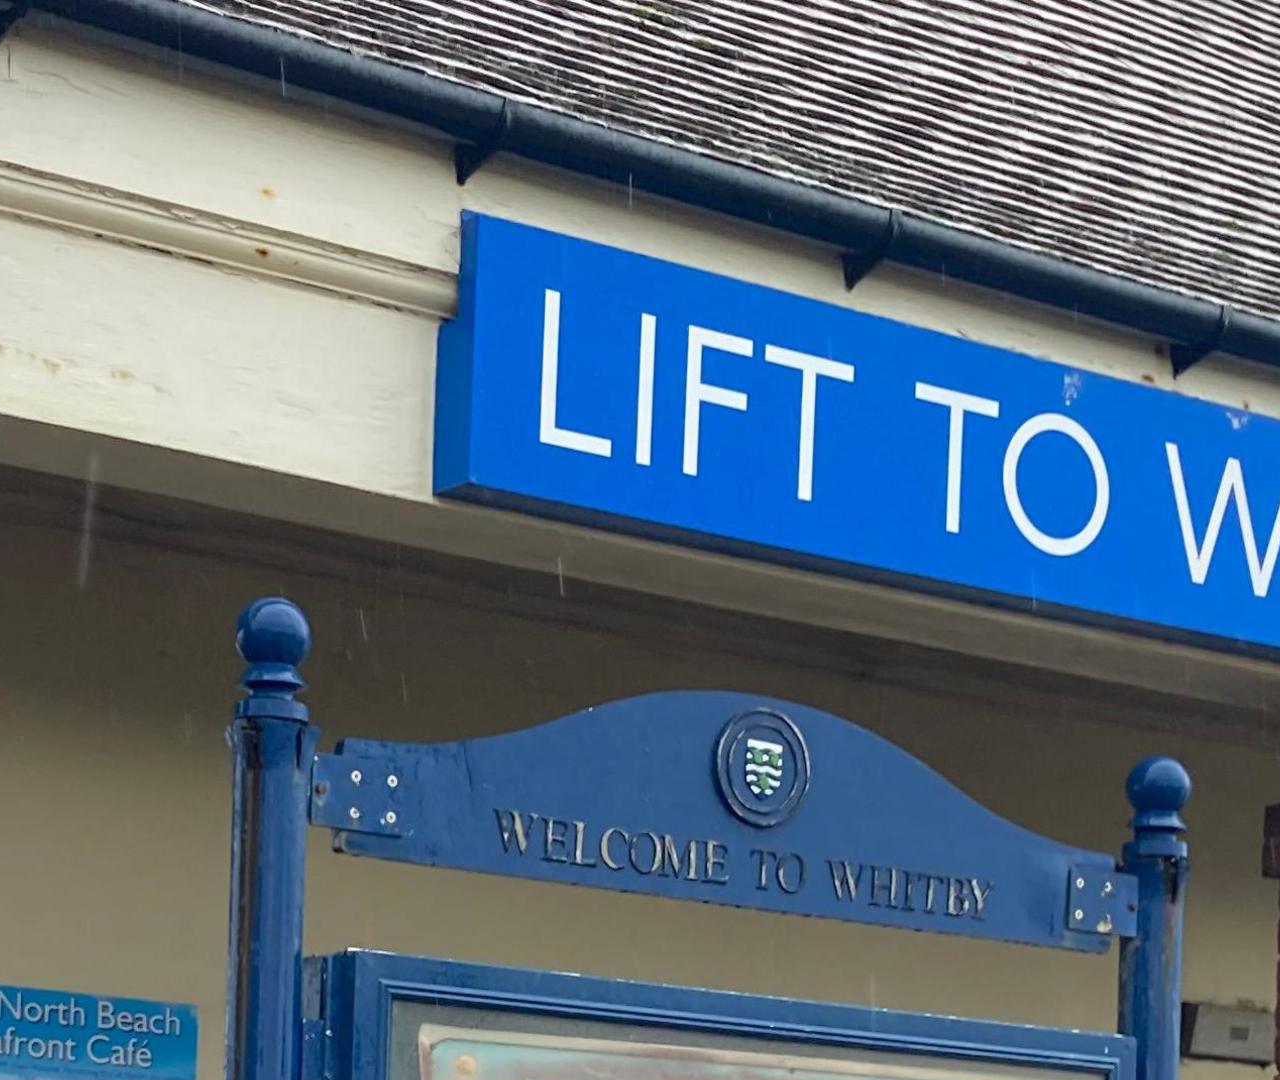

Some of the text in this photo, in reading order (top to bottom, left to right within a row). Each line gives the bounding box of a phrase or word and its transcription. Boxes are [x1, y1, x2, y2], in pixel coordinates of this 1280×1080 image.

[539, 288, 855, 502] LIFT
[915, 381, 1110, 557] TO
[492, 807, 996, 921] WELCOME TO WHITBY
[87, 1034, 154, 1068] Café
[97, 1001, 182, 1036] Beach
